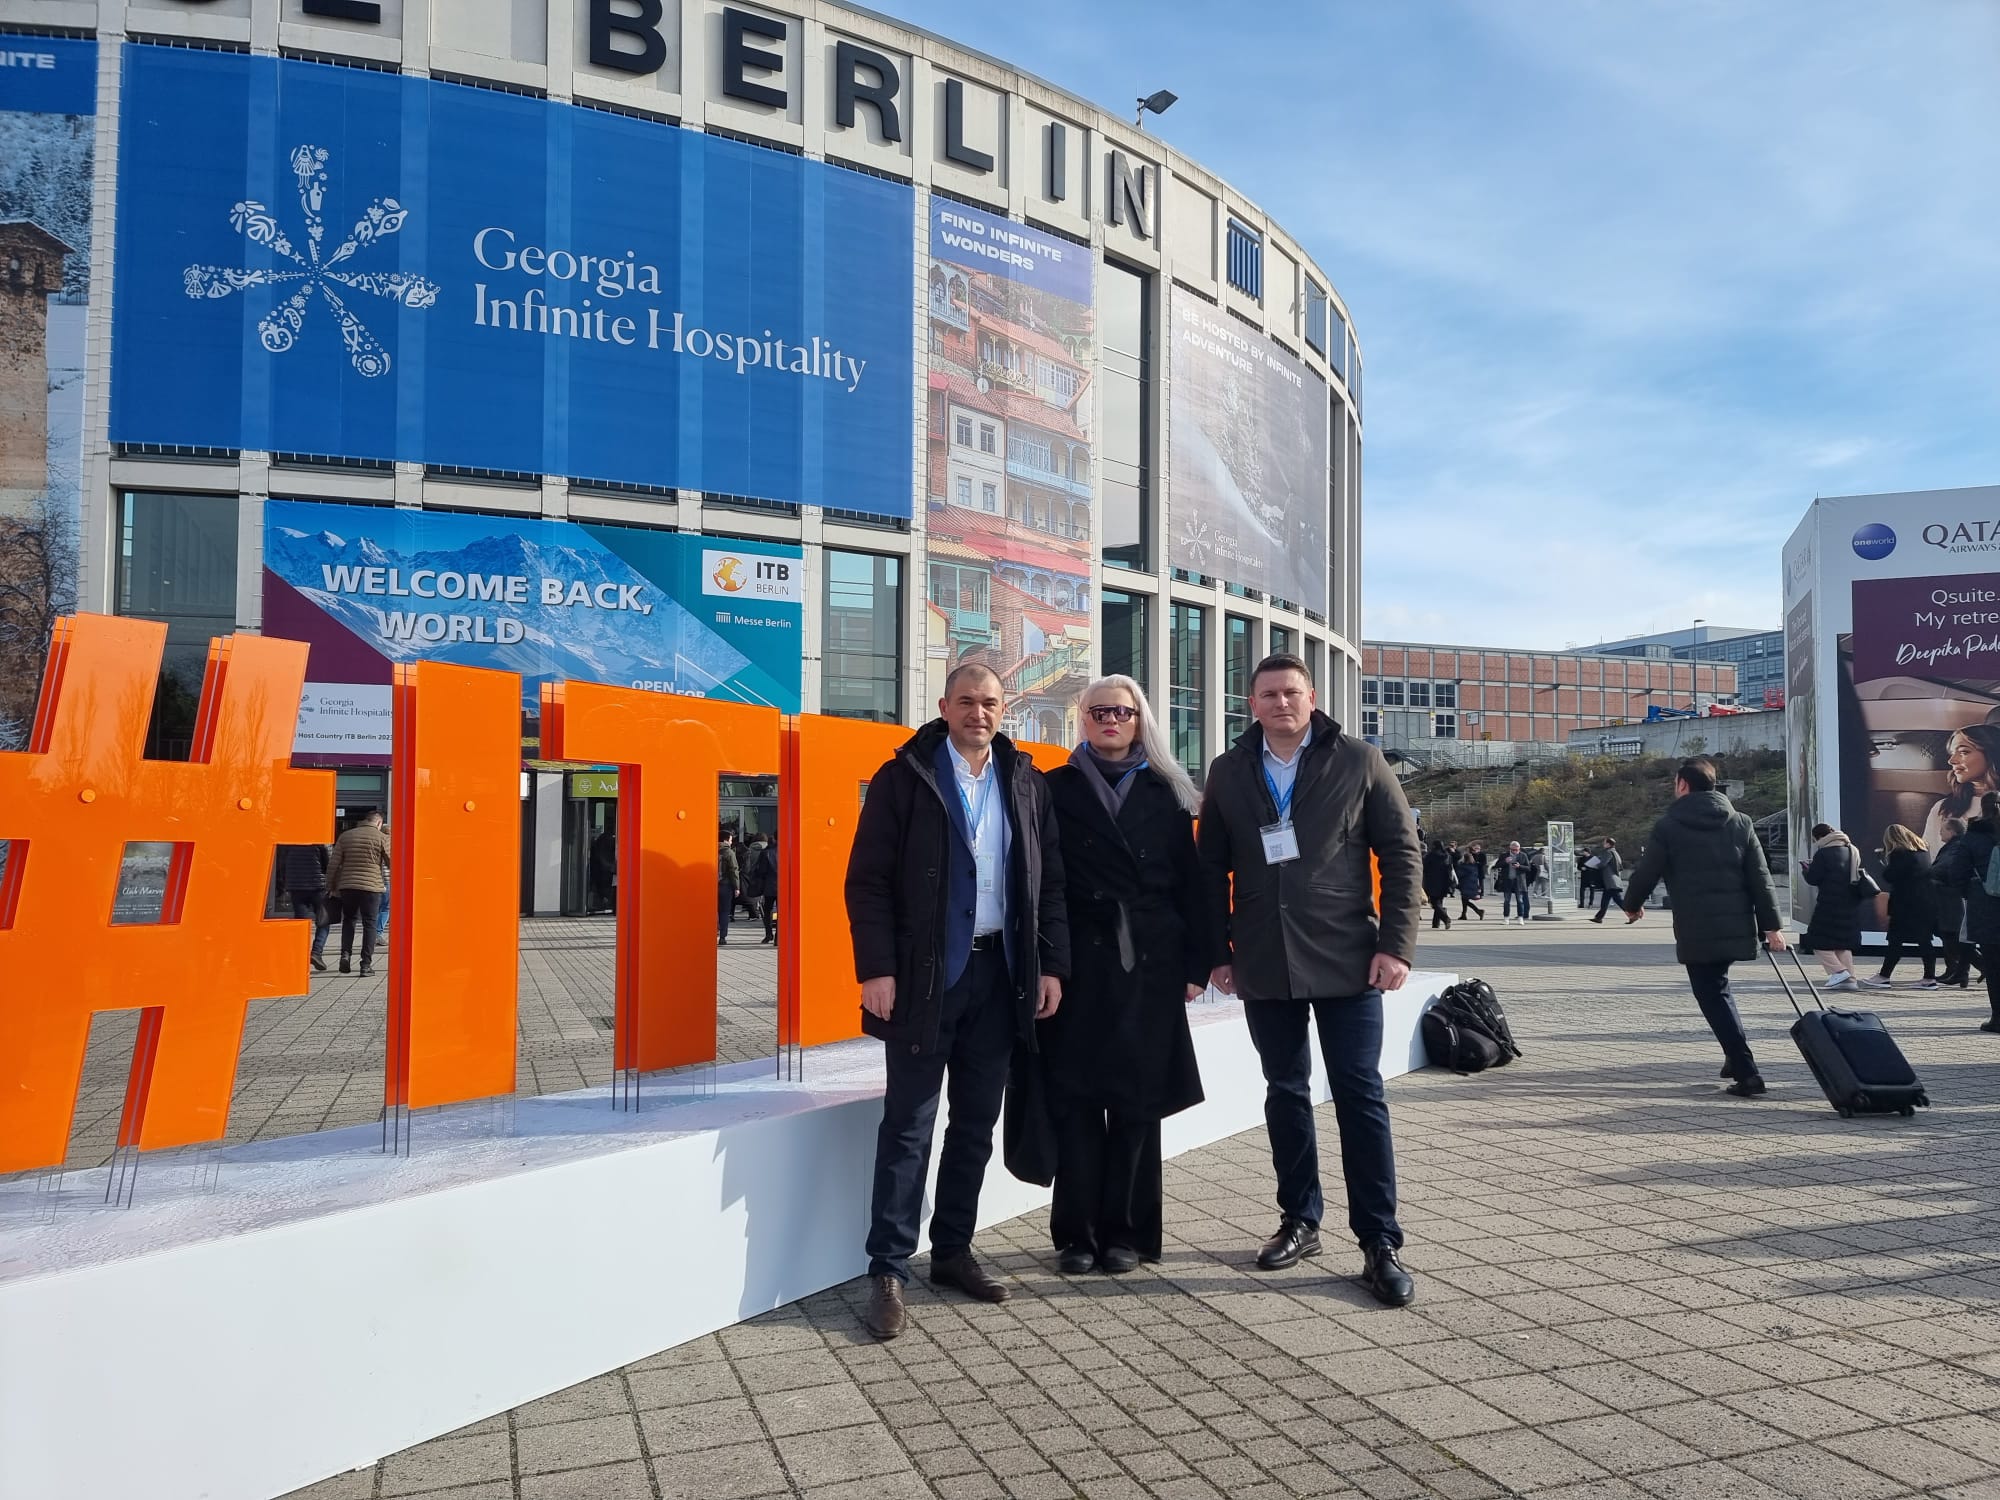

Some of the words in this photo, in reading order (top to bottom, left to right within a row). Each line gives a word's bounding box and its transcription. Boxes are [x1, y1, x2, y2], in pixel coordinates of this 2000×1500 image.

[0, 50, 56, 69] ITE
[589, 0, 1153, 238] BERLIN
[940, 211, 985, 236] FIND
[990, 226, 1062, 263] INFINITE
[940, 231, 1034, 271] WONDERS
[473, 227, 661, 298] Georgia
[474, 283, 636, 345] Infinite
[648, 307, 866, 393] Hospitality
[1182, 307, 1200, 327] BE
[1202, 317, 1249, 353] HOSTED
[1251, 345, 1265, 362] BY
[1266, 354, 1302, 389] INFINITE
[1182, 331, 1254, 375] ADVENTURE
[1854, 536, 1895, 546] oneworld
[1949, 543, 1997, 553] AIRWAYS
[756, 561, 790, 581] ITB
[322, 564, 528, 603] WELCOME
[542, 577, 652, 615] BACK,
[756, 584, 789, 595] BERLIN
[378, 611, 524, 644] WORLD
[734, 615, 764, 626] Messe
[765, 618, 792, 628] Berlin
[1914, 612, 1946, 630] My
[1895, 637, 1962, 666] Deepika
[632, 680, 674, 694] OPEN
[319, 697, 354, 707] Georgia
[319, 706, 349, 716] Infinite
[316, 732, 343, 741] Country
